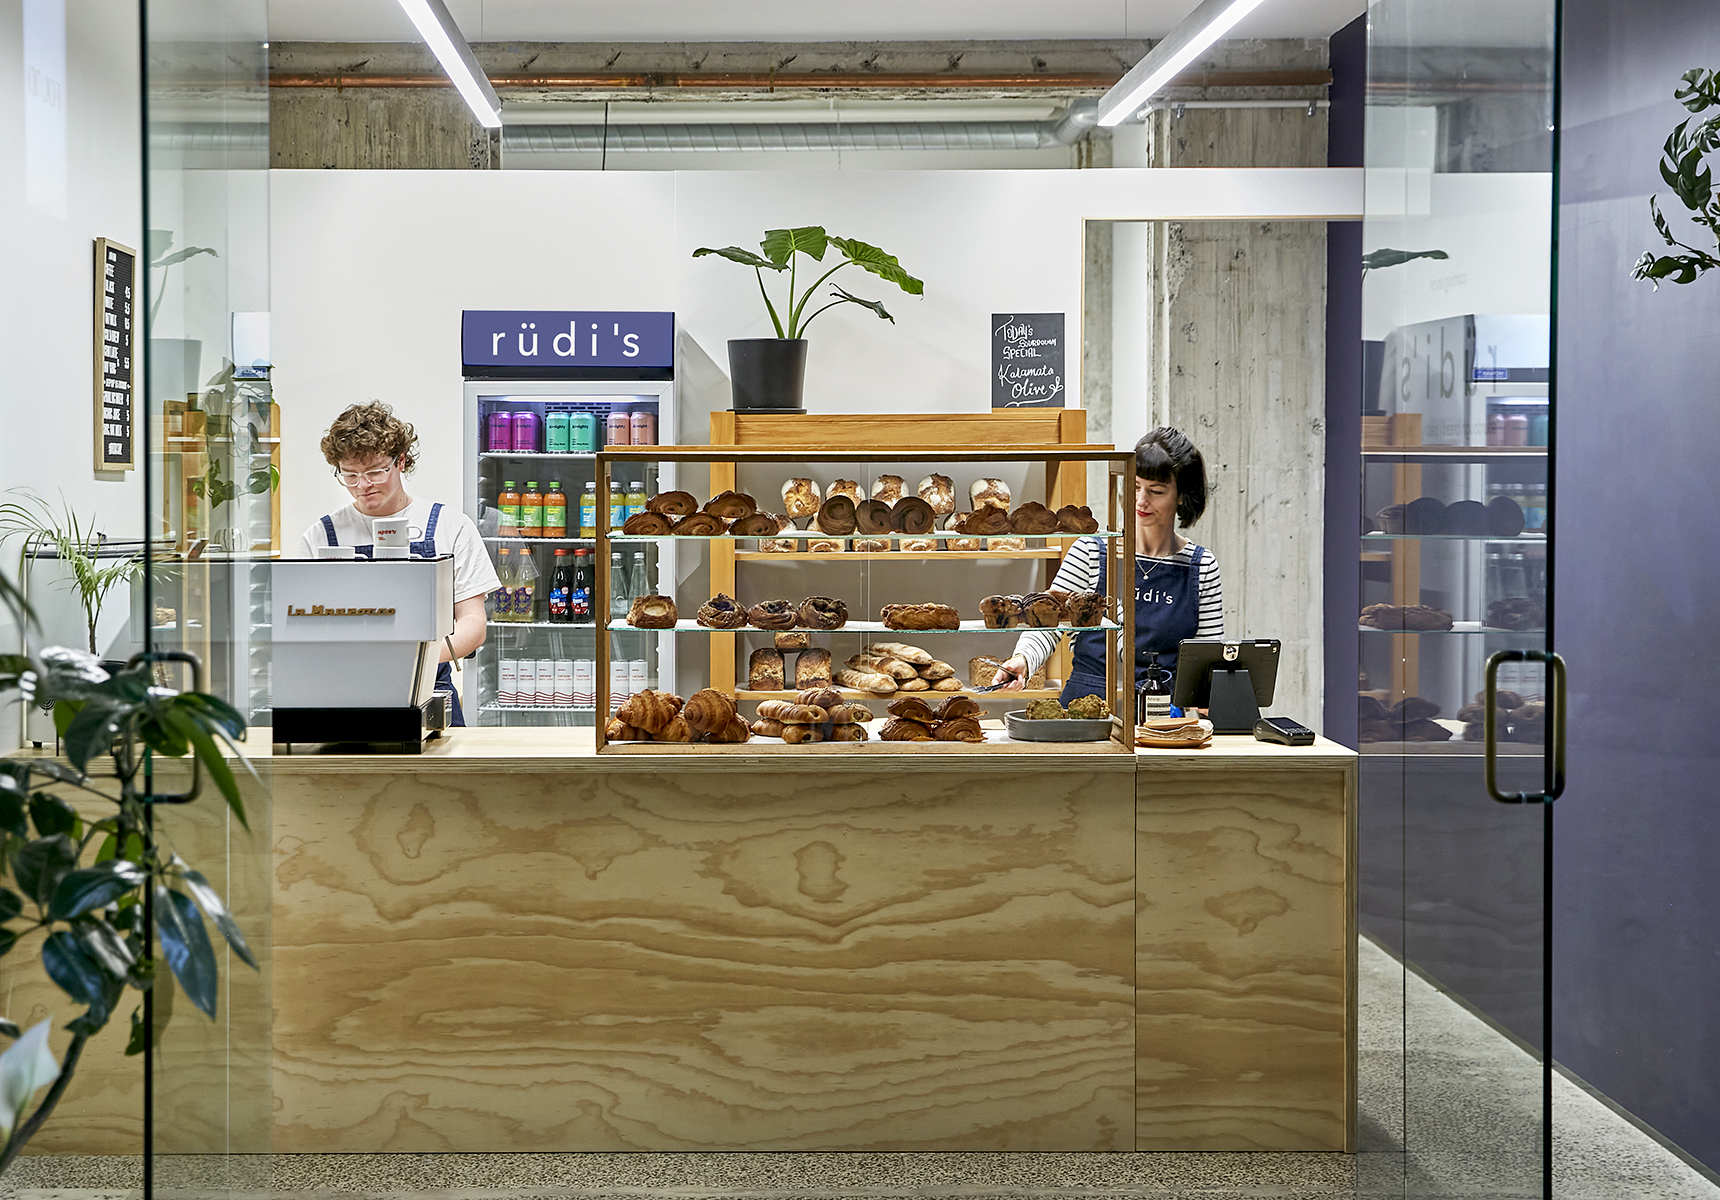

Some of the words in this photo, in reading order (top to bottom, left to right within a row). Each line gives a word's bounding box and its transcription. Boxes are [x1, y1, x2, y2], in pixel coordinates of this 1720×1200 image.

[492, 320, 640, 357] rüdi's
[1003, 346, 1042, 360] SPECIAL
[998, 363, 1054, 387] Kalamata
[1011, 378, 1047, 399] Olive
[1135, 588, 1174, 604] üdi's
